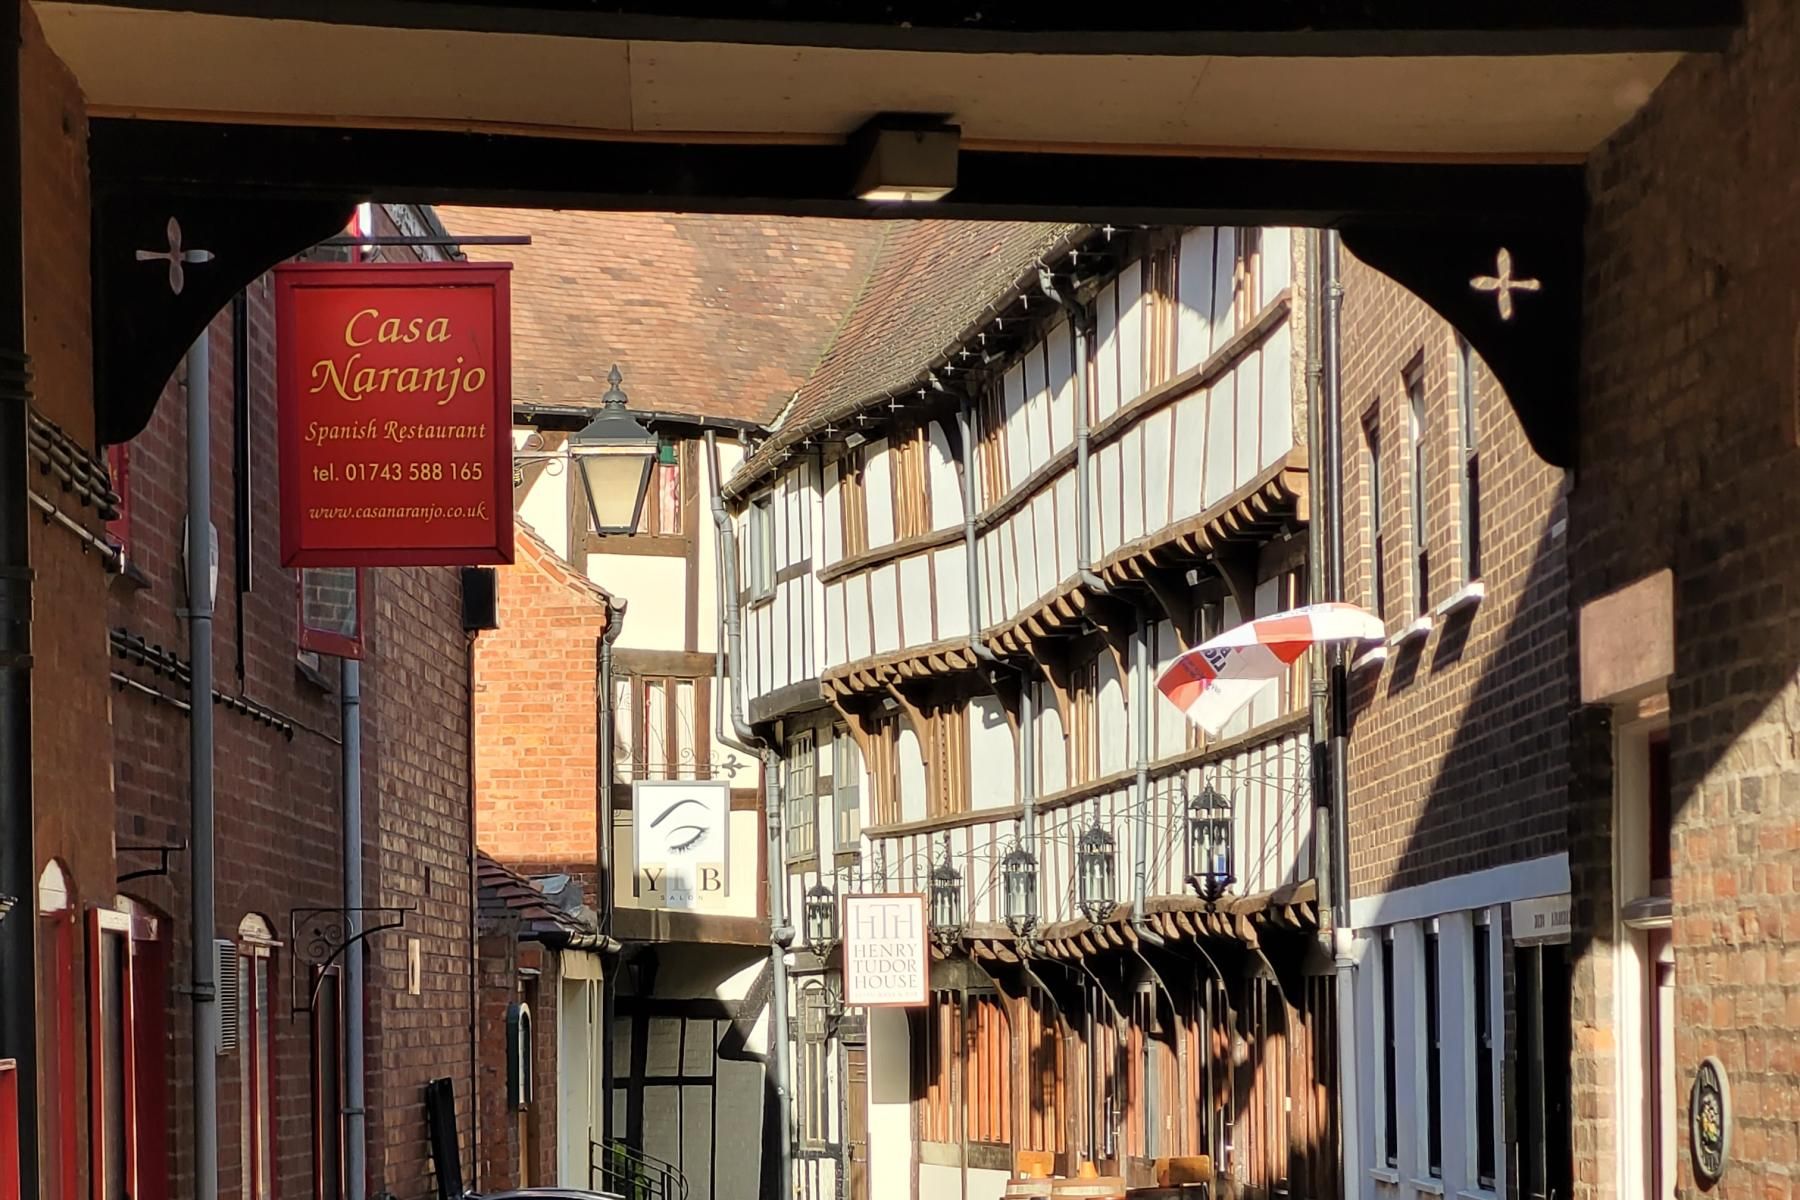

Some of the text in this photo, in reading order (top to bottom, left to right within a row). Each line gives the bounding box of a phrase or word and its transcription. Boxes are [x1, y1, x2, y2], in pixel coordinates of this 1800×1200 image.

[345, 309, 452, 348] Casa
[310, 353, 486, 405] Naranjo
[305, 418, 487, 446] Spanish Restaurant
[313, 463, 483, 482] tel. 01743 588 165
[309, 500, 488, 523] www.casanaranjo.co.uk
[854, 944, 917, 958] HENRY
[853, 959, 918, 974] TUDOR
[855, 975, 918, 989] HOUSE
